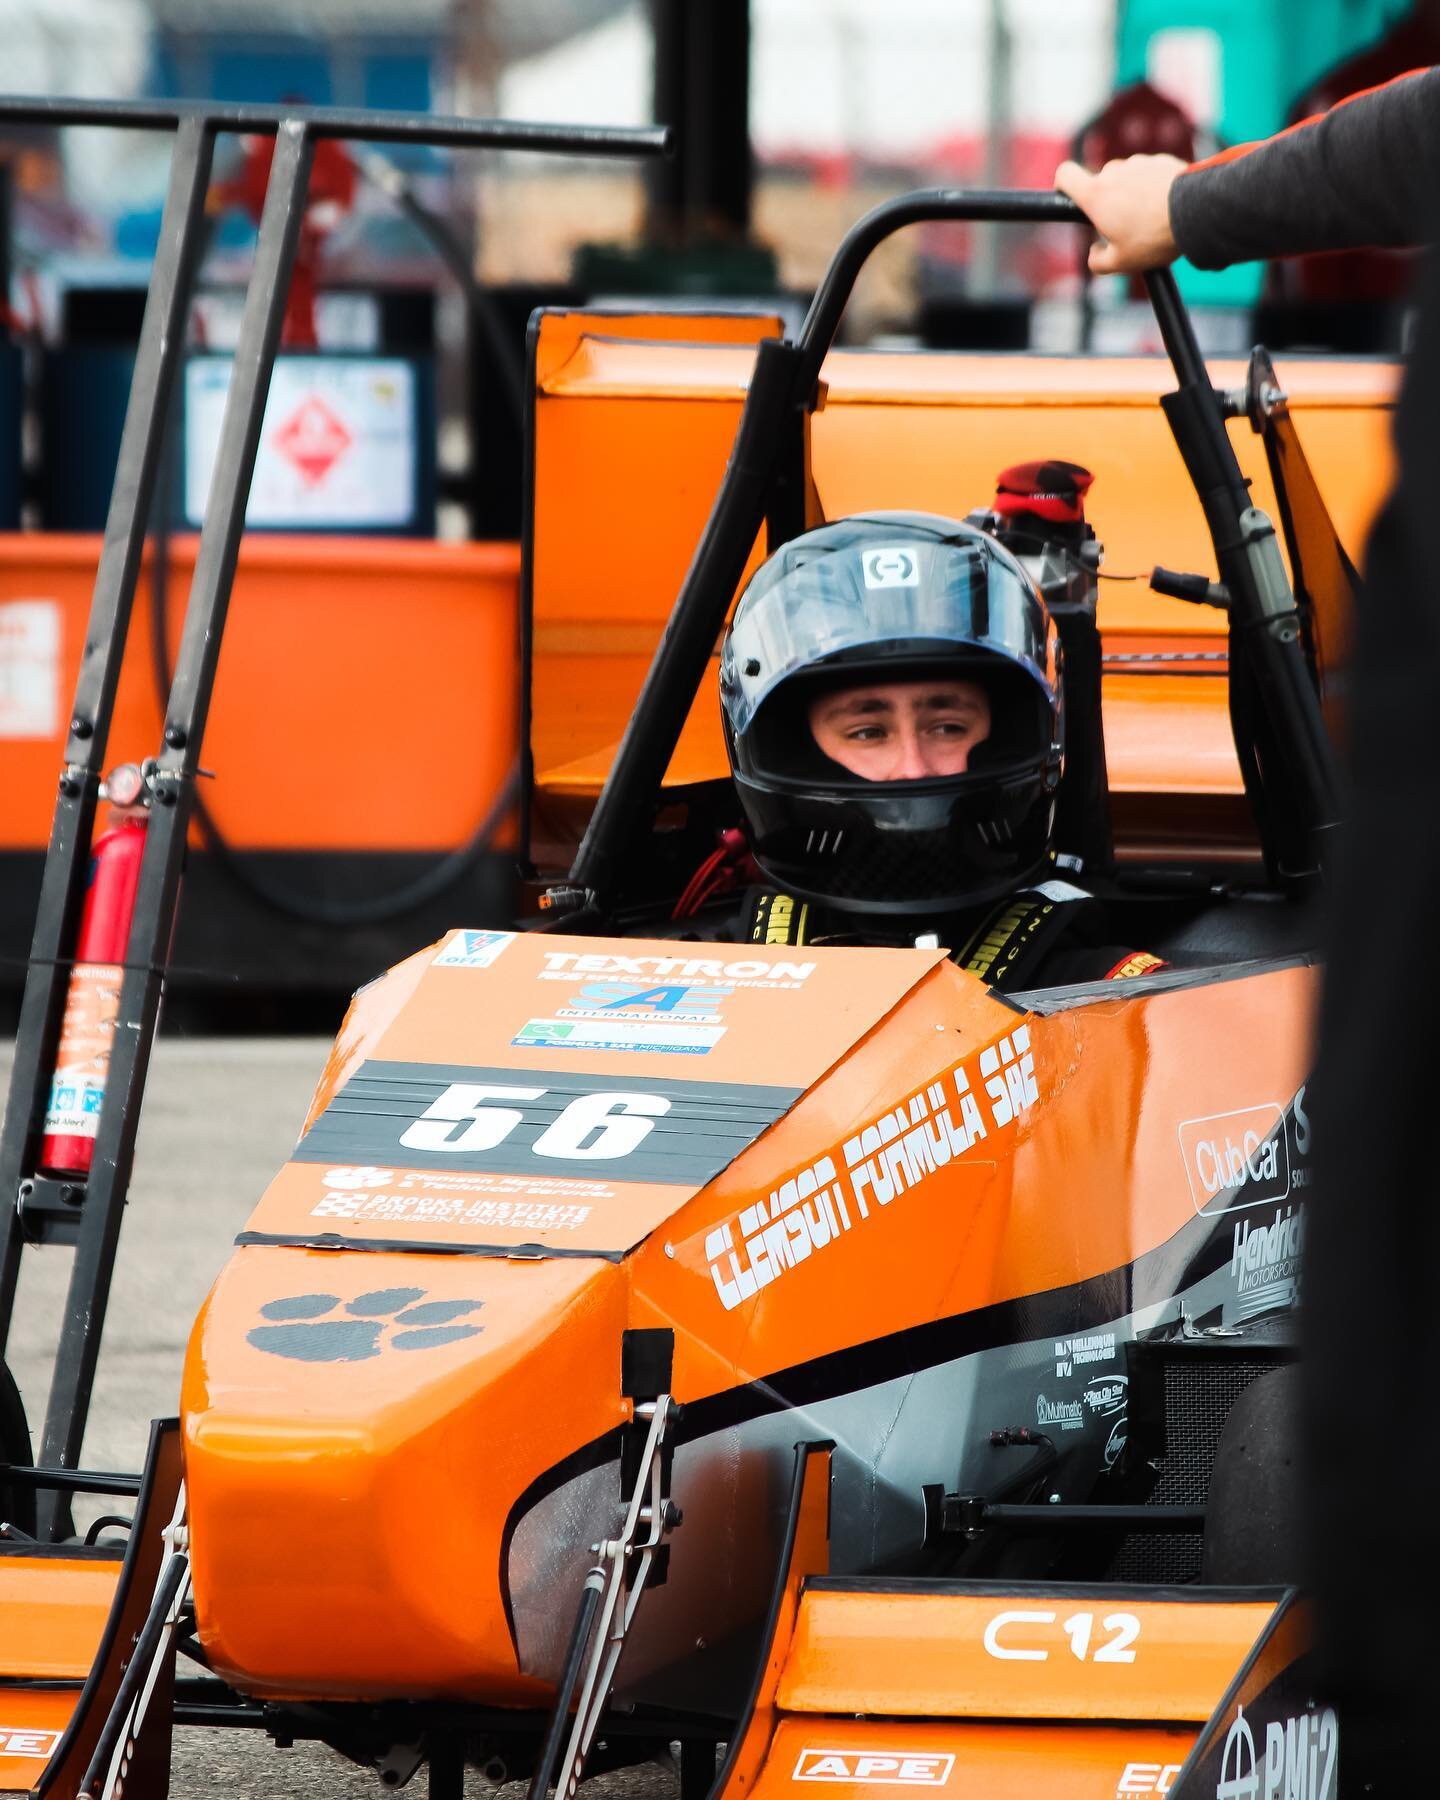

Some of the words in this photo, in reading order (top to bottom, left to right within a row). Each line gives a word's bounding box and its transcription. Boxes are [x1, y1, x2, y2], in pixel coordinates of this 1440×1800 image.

[446, 957, 483, 965] OFF
[543, 952, 818, 980] TEXTRON
[712, 978, 803, 989] VEHICLES
[567, 981, 737, 1015] SAE
[559, 1009, 708, 1023] INTERNATIONAL
[545, 1039, 606, 1049] FORMULA
[638, 1043, 702, 1053] MICHIGAN
[399, 1083, 672, 1161] 56
[704, 1155, 852, 1312] CLEMSON
[842, 1066, 988, 1220] FORMULA
[979, 1024, 1040, 1128] SAE
[363, 1203, 405, 1214] FOR
[413, 1204, 588, 1224] MOTORSPORTS
[370, 1194, 465, 1208] BROOKS
[471, 1199, 593, 1216] INSTITUTE
[353, 1211, 454, 1225] CLEMSON
[458, 1216, 584, 1231] UNIVERSITY
[1046, 1400, 1083, 1421] Multimatic
[983, 1611, 1141, 1663] C12
[805, 1756, 939, 1779] APE
